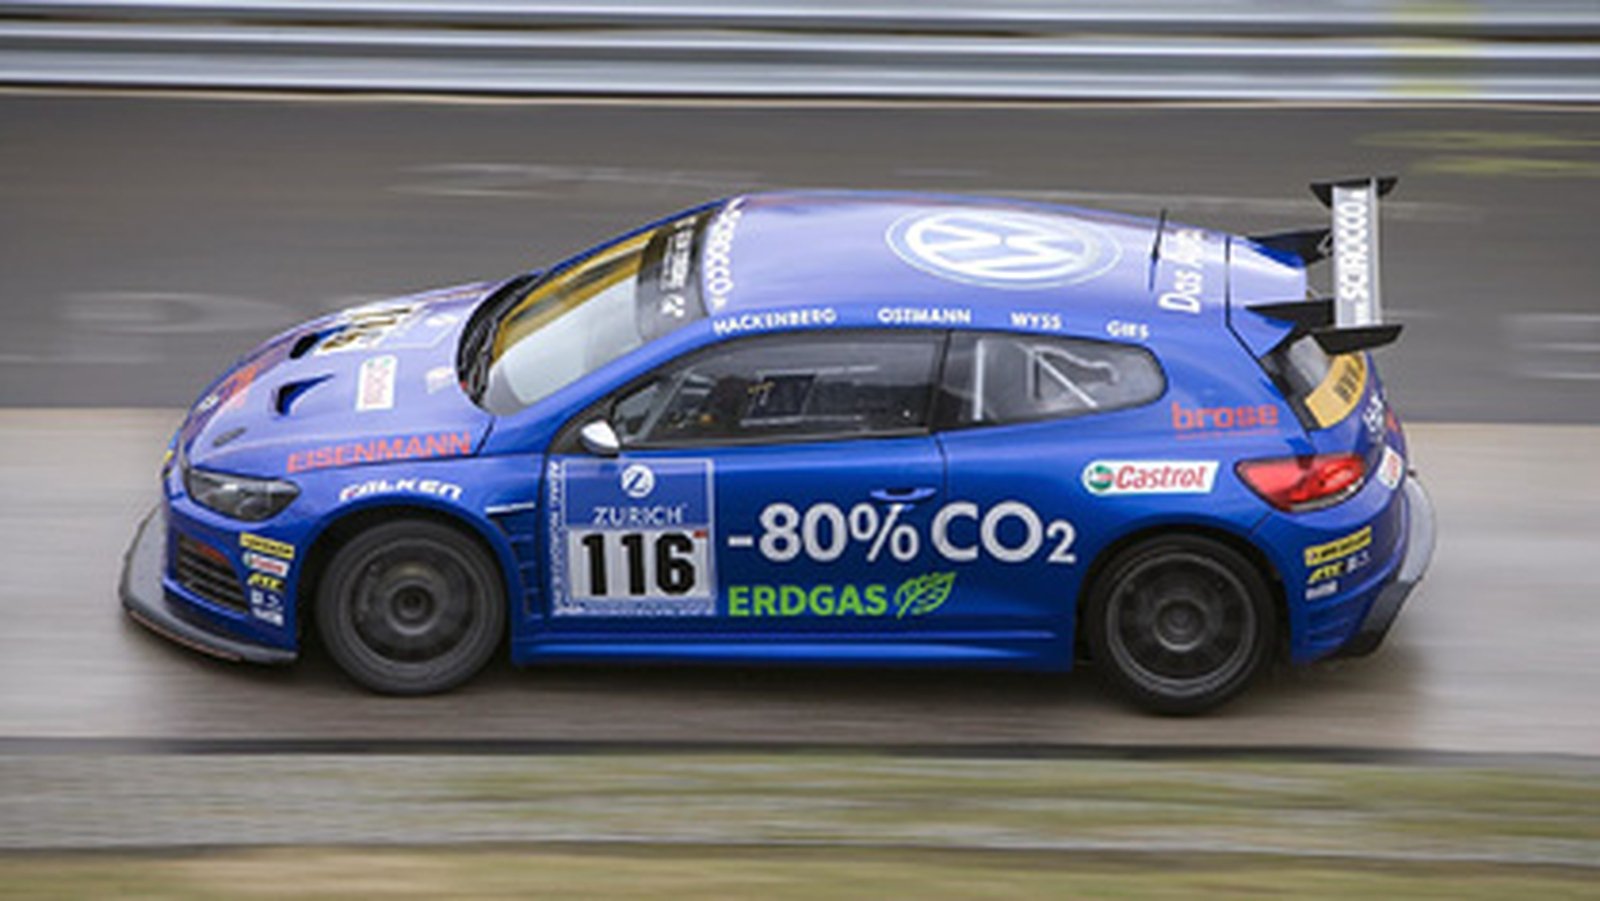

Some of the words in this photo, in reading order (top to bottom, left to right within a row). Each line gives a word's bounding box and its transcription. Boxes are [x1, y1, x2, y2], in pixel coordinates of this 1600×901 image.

[1158, 270, 1203, 314] Das
[713, 308, 837, 335] HACKENBERG
[1010, 311, 1062, 331] WYSS
[1106, 319, 1150, 340] GIES
[1171, 401, 1279, 430] brose
[286, 431, 471, 474] EISENMANN
[339, 478, 462, 502] FALKEN
[1115, 464, 1207, 490] Castrol
[592, 506, 684, 526] ZURICH
[727, 502, 920, 563] -80%
[581, 532, 695, 597] 116
[728, 585, 888, 617] ERDGAS
